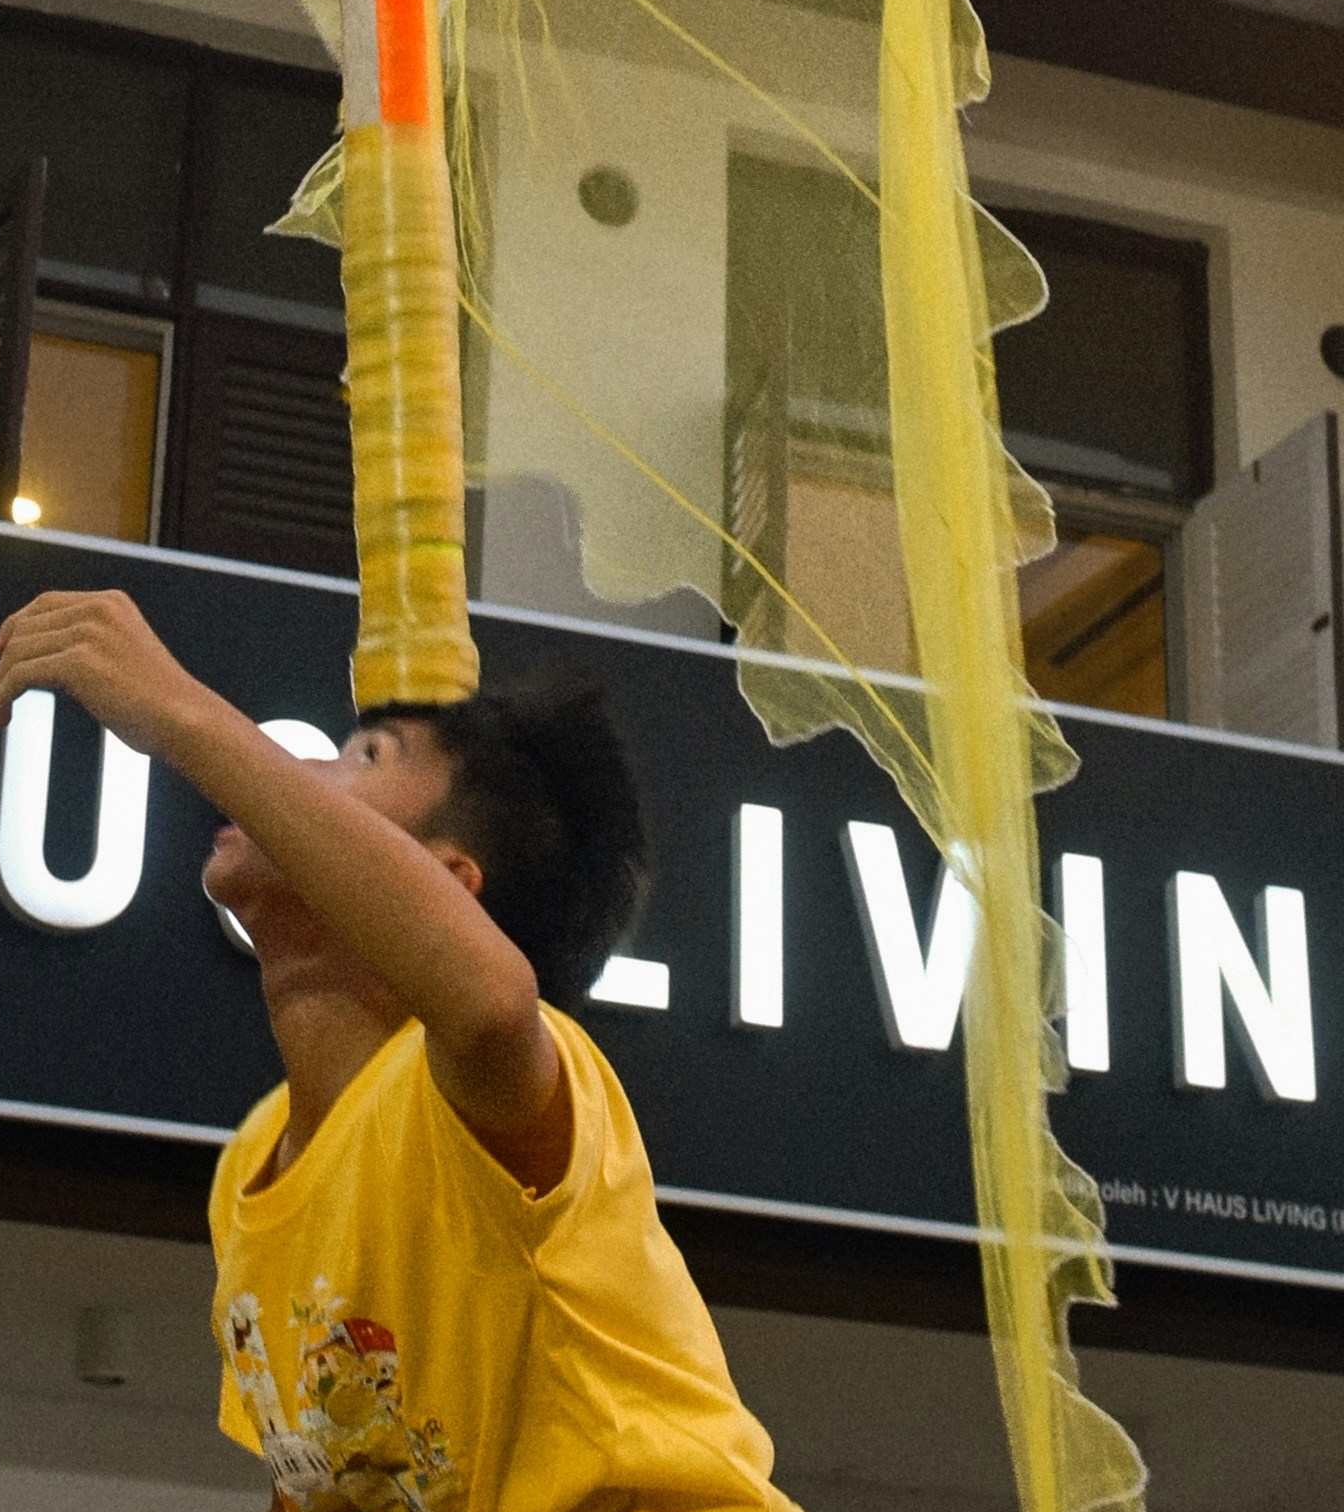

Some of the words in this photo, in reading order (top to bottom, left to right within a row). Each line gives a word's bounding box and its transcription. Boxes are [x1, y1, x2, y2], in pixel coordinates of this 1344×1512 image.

[1102, 1179, 1146, 1206] oleh
[1163, 1185, 1180, 1210] V
[1185, 1190, 1247, 1219] HAUS
[1253, 1199, 1327, 1231] LIVING
